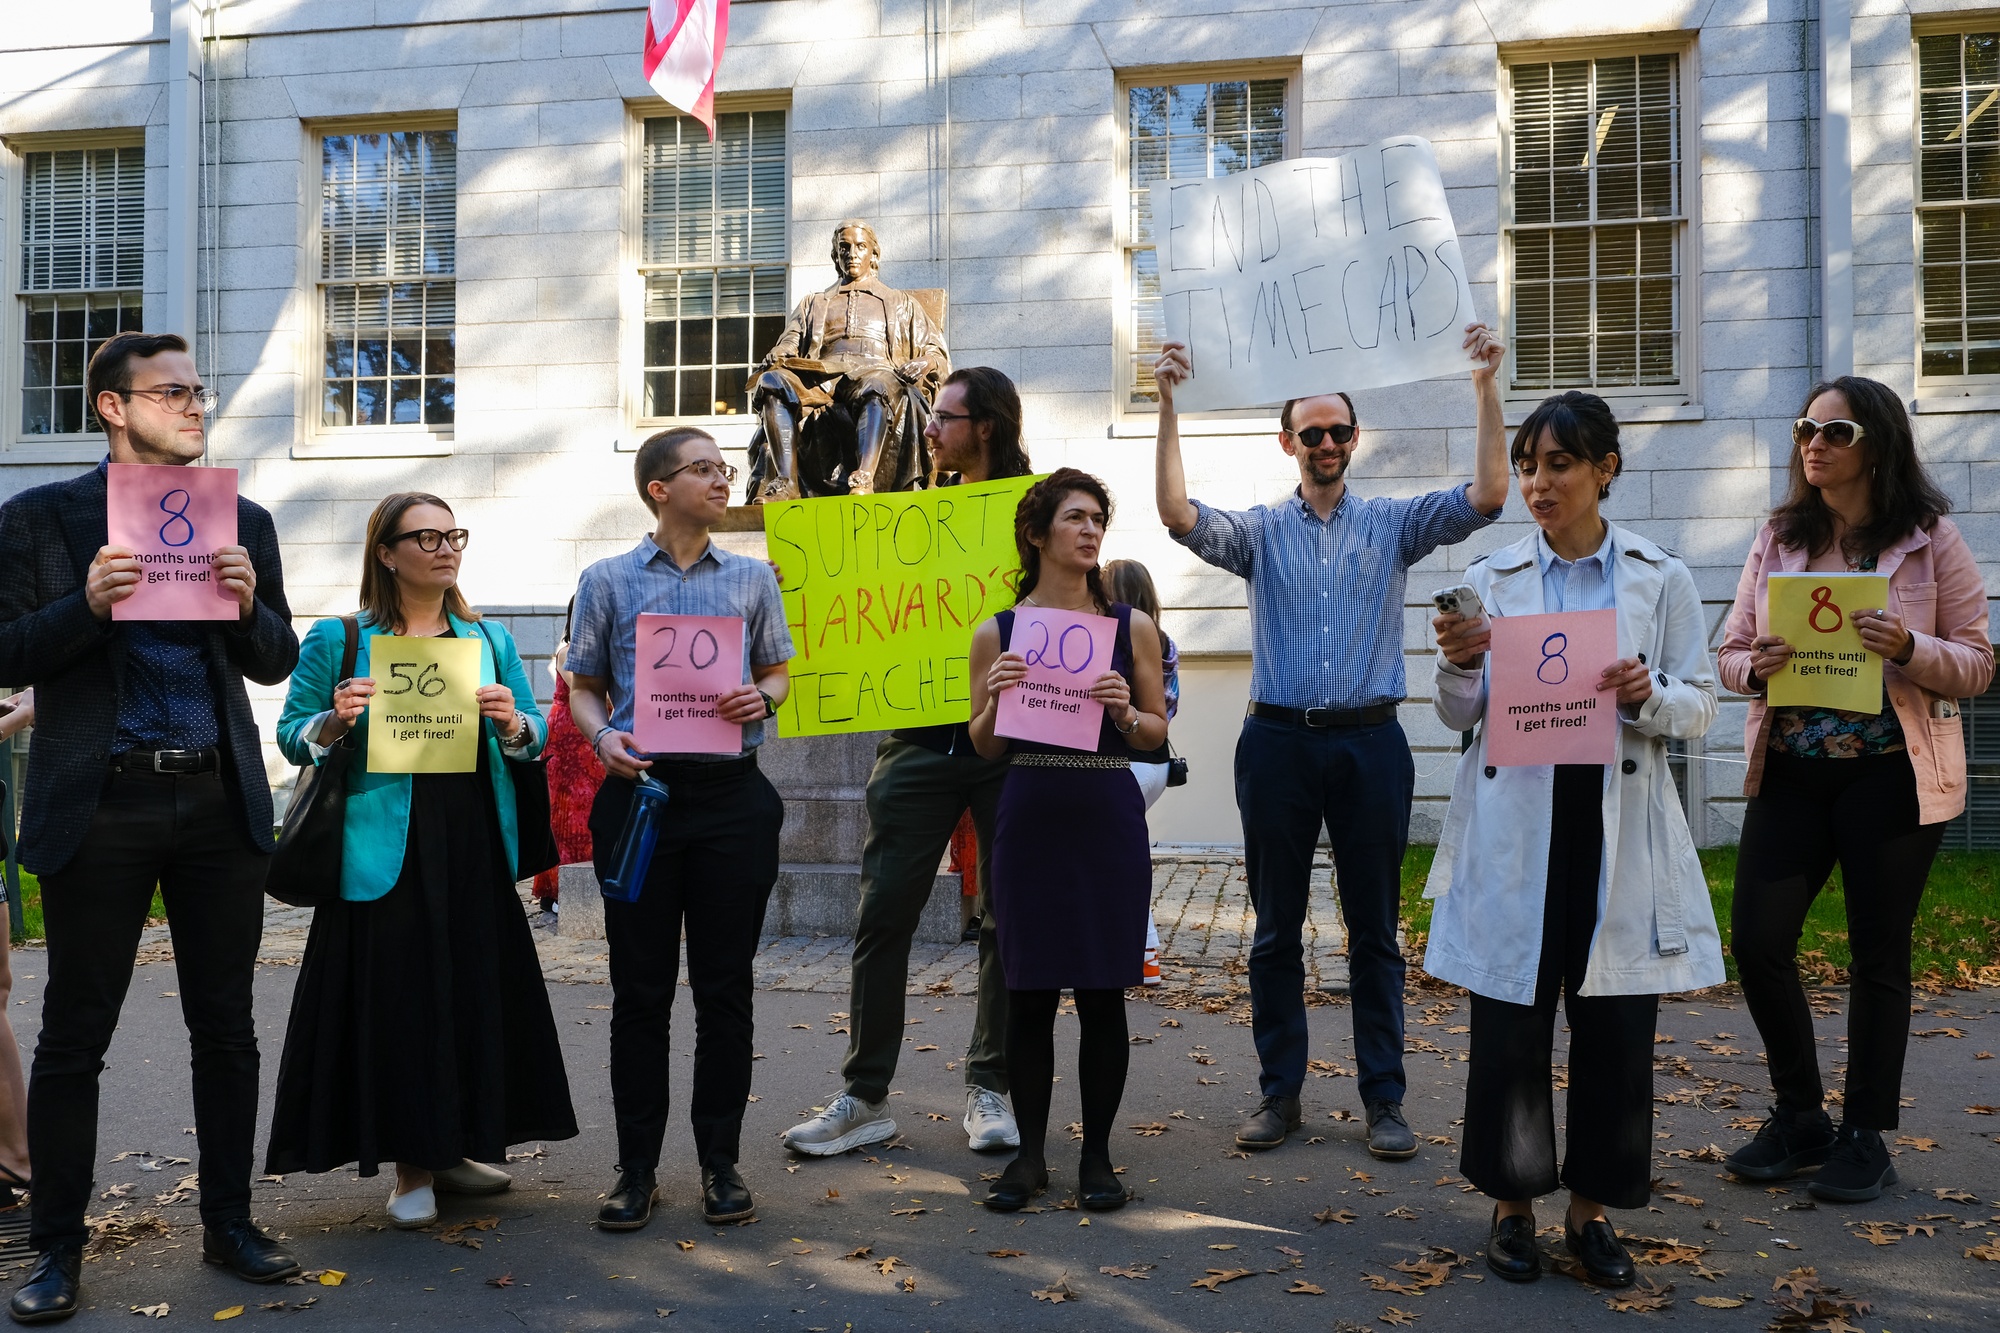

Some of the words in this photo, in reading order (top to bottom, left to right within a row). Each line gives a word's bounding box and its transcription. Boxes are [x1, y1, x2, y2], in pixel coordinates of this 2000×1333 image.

[1170, 177, 1281, 273] END
[1293, 143, 1442, 238] THE
[159, 489, 195, 547] 8
[774, 490, 1013, 593] SUPPORT
[188, 552, 216, 565] unti
[147, 570, 171, 584] get
[174, 569, 211, 582] fired!
[1808, 585, 1843, 634] 8
[652, 626, 719, 670] 20
[1025, 620, 1094, 675] 20
[1536, 632, 1569, 685] 8
[1838, 652, 1867, 663] until
[1800, 664, 1822, 676] get
[1825, 664, 1858, 678] fired!
[383, 662, 447, 698] 56
[651, 692, 697, 703] months
[700, 692, 723, 703] unt
[788, 657, 970, 731] TEACHE
[1016, 680, 1061, 695] months
[1064, 688, 1091, 700] until
[664, 708, 684, 720] get
[687, 707, 719, 718] fired!
[1027, 697, 1047, 709] get
[1050, 699, 1081, 714] fired!
[1508, 701, 1562, 715] months
[1565, 698, 1597, 711] until
[385, 713, 433, 724] months
[436, 713, 463, 724] until
[1523, 718, 1547, 732] get
[1550, 715, 1587, 729] fired!
[400, 729, 420, 741] get
[423, 729, 455, 739] fired!
